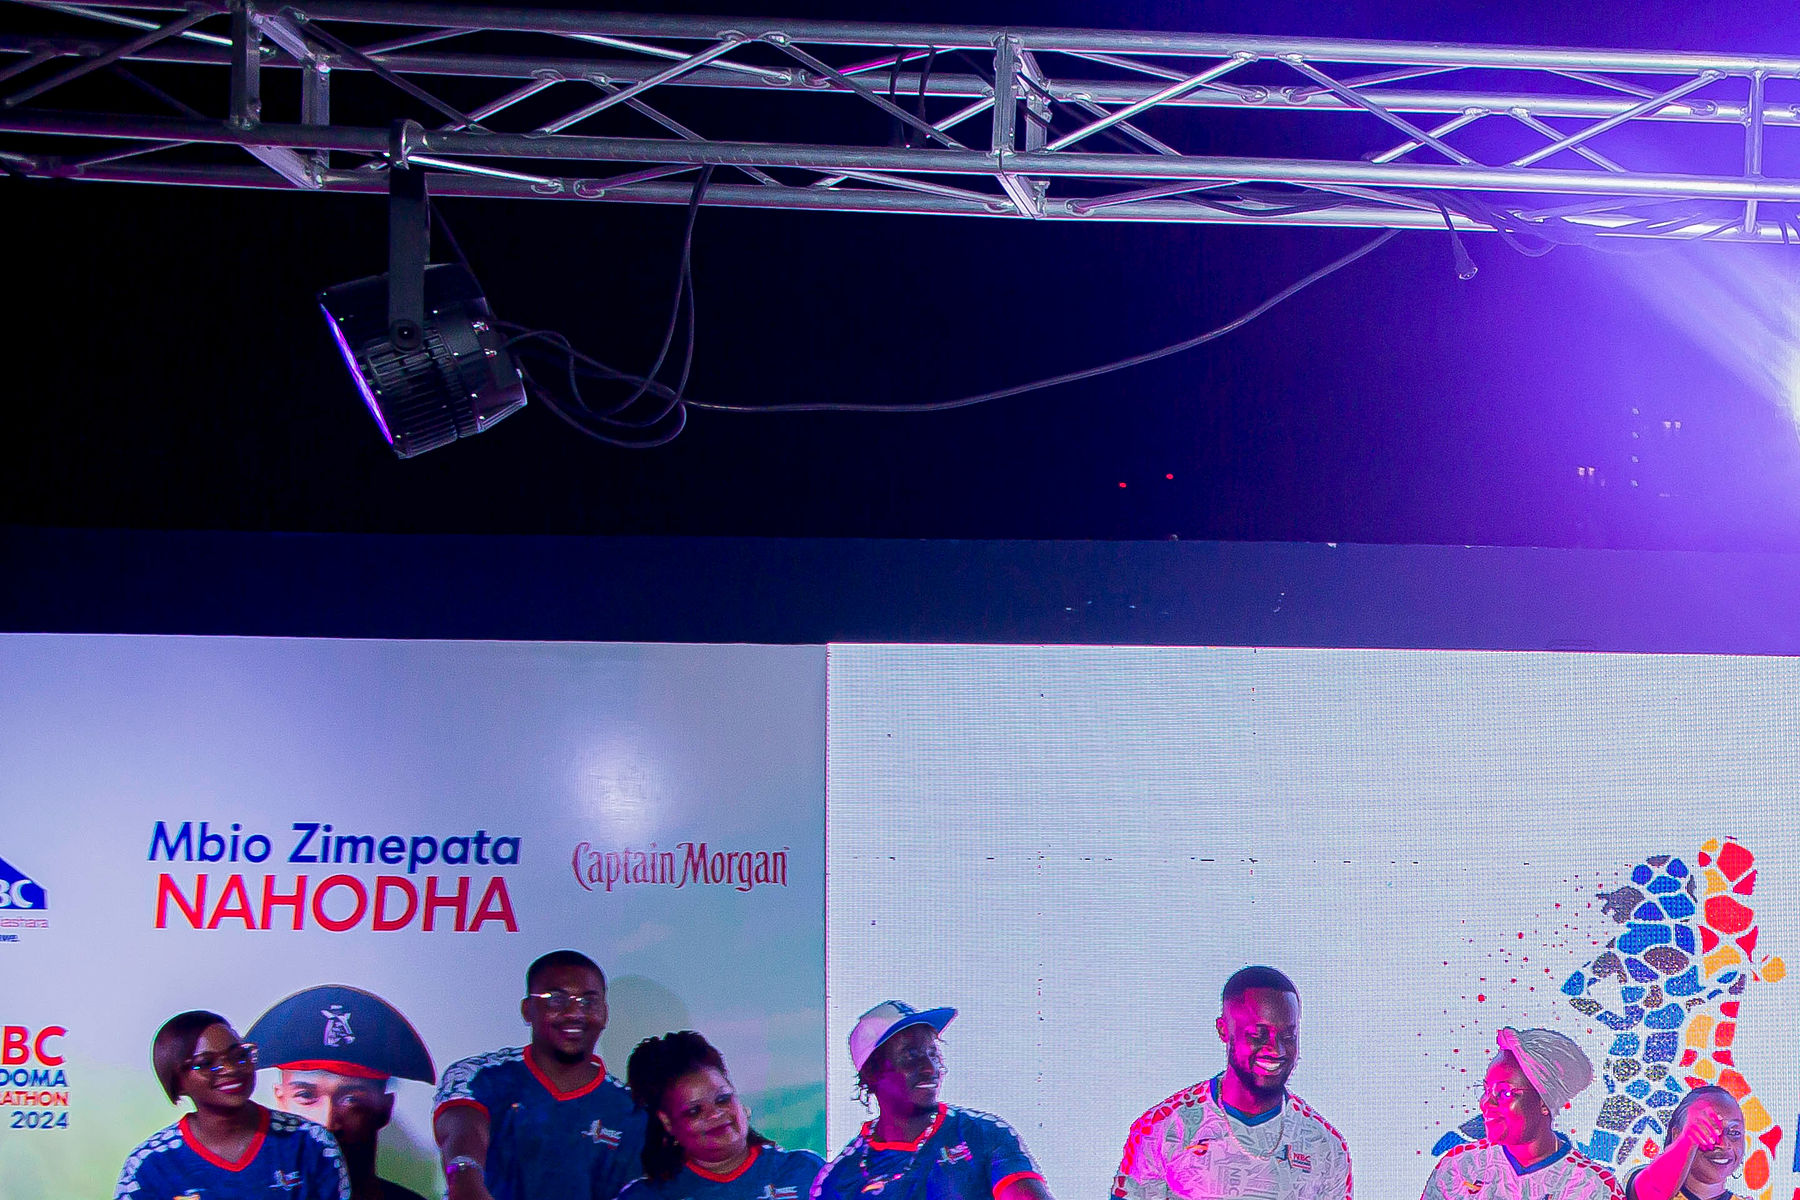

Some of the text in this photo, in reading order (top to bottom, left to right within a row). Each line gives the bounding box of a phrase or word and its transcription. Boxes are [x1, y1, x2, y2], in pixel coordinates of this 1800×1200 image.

[149, 821, 522, 874] Mbio Zimepata
[571, 842, 790, 891] Captain Morgan
[154, 873, 521, 932] NAHODHA
[1, 1025, 68, 1067] BC
[0, 1091, 69, 1106] ATHON
[10, 1110, 69, 1130] 2024
